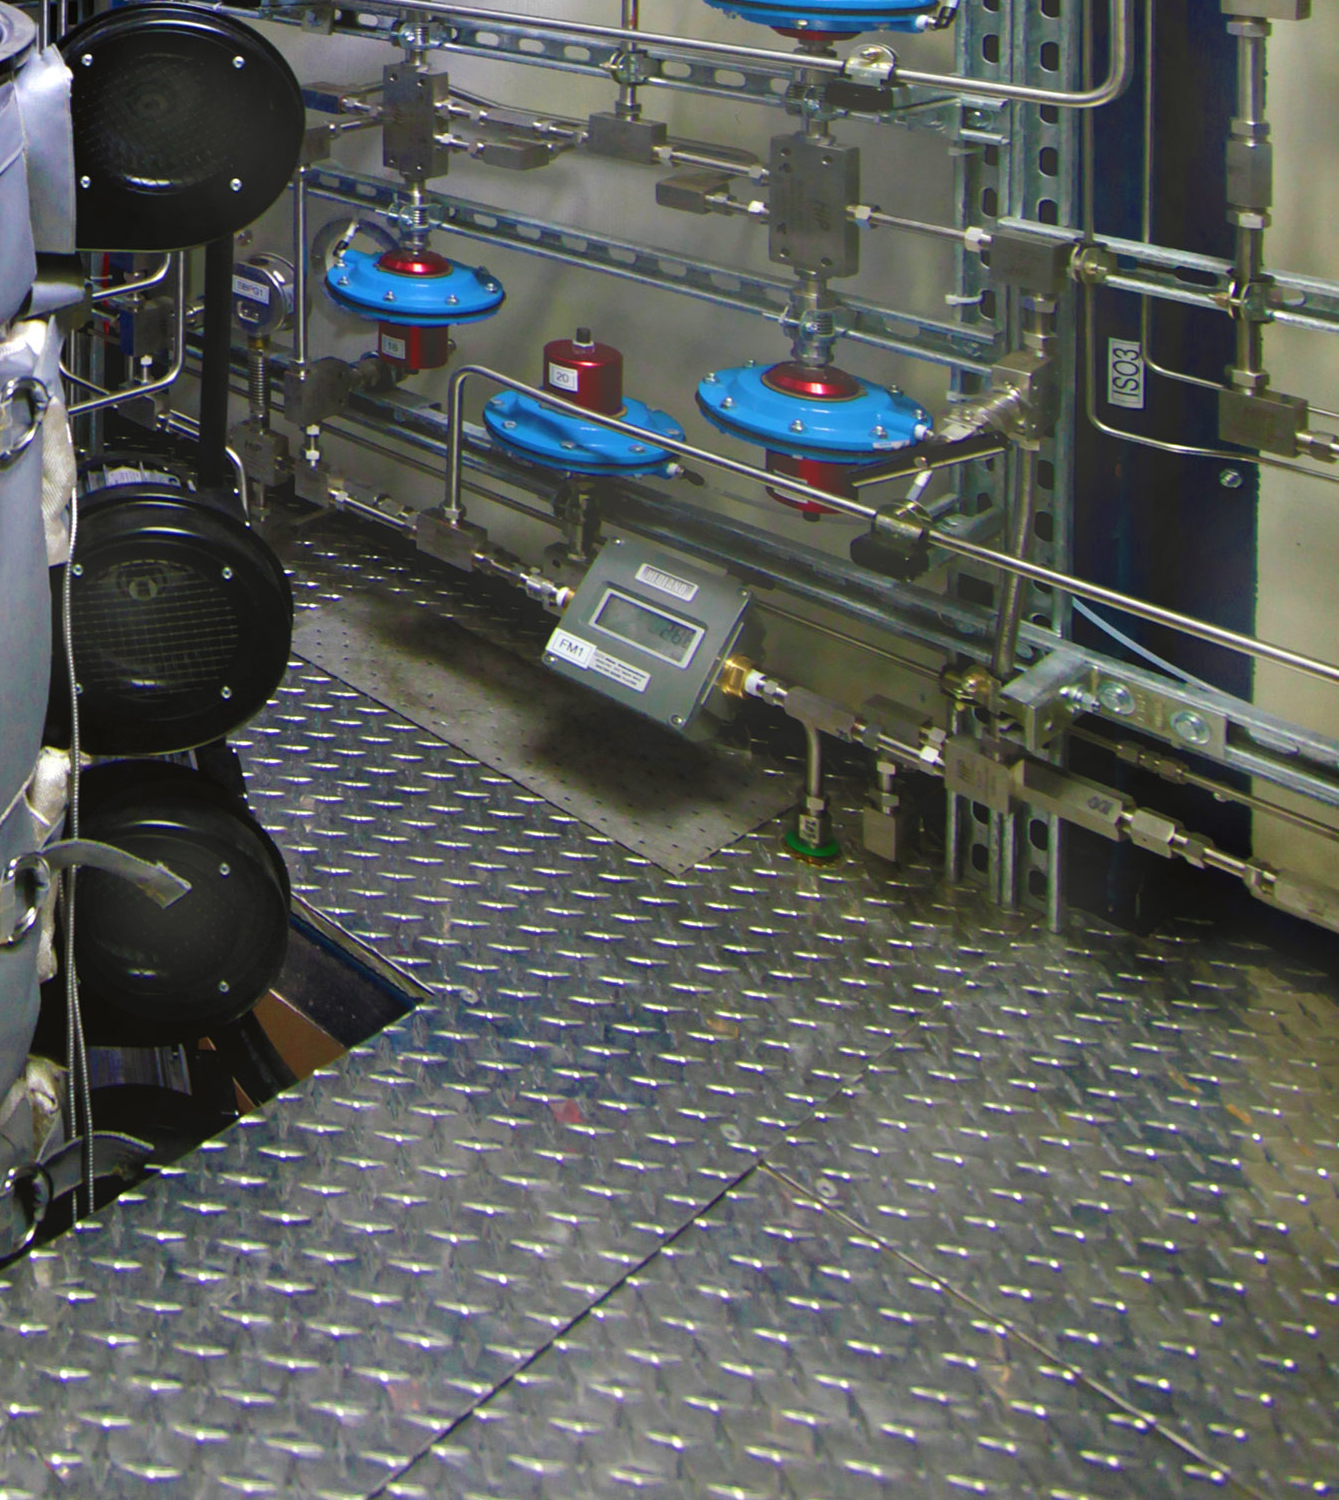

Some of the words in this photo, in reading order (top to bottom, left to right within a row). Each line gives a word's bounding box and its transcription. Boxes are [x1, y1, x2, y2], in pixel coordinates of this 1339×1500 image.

[556, 371, 570, 383] 20
[1112, 347, 1139, 397] ISO3
[559, 638, 585, 658] FM1
